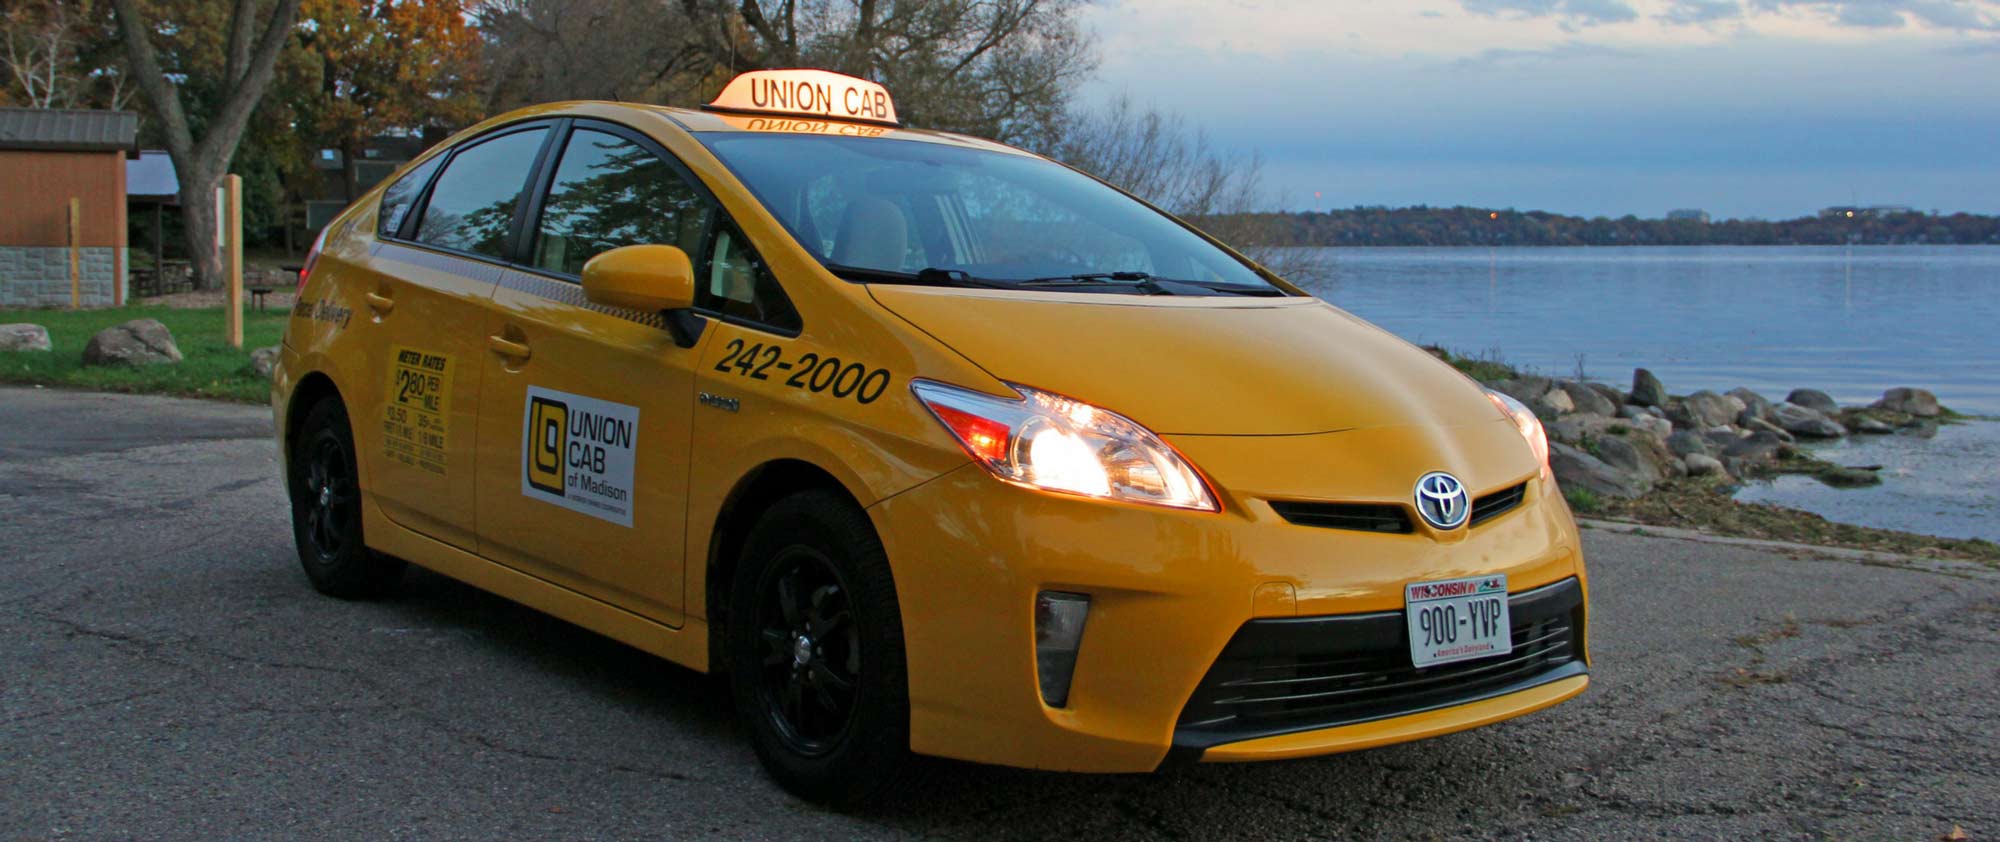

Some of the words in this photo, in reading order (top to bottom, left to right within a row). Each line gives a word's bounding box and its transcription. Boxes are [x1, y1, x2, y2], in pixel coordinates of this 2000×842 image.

[751, 78, 831, 112] UNION
[844, 87, 887, 119] CAB
[398, 349, 421, 366] METER
[423, 354, 446, 371] RATES
[714, 338, 891, 405] 242-2000
[427, 375, 440, 392] PER
[570, 409, 632, 449] UNION
[568, 441, 606, 475] CAB
[568, 472, 578, 487] of
[581, 474, 627, 502] Madison
[1411, 582, 1467, 599] WISCONSIN
[1420, 598, 1501, 648] 900-YVP
